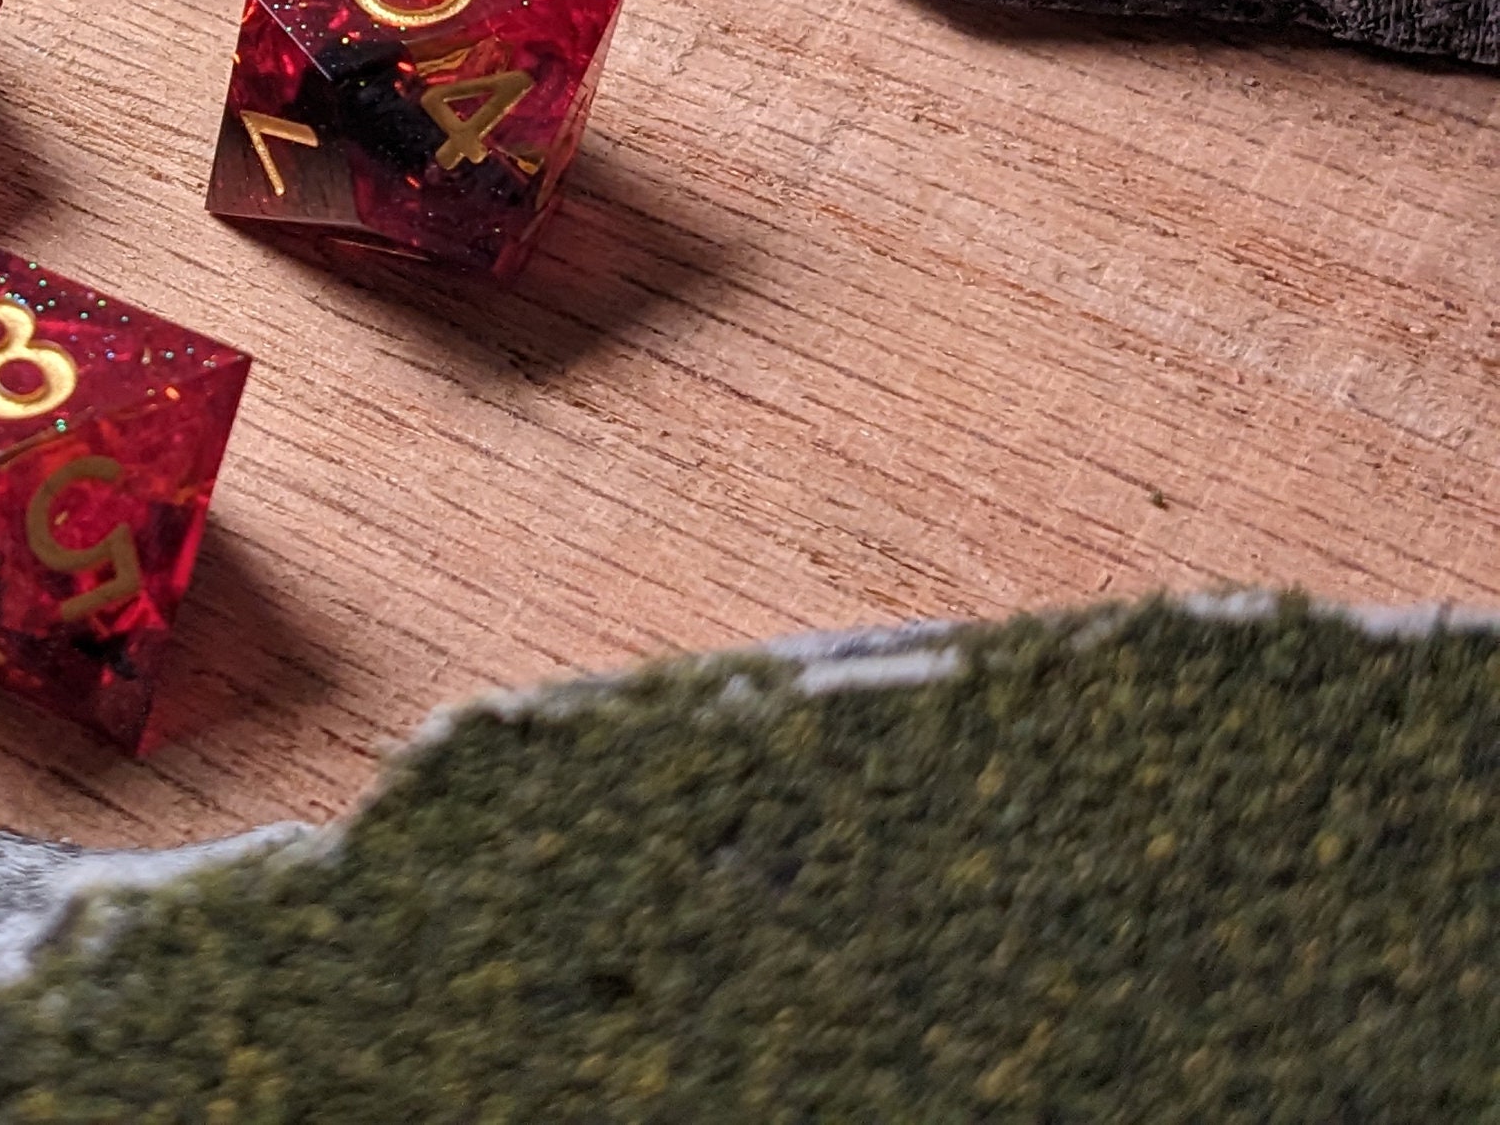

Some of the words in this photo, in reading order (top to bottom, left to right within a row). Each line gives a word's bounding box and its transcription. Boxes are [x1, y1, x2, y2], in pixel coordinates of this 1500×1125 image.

[239, 110, 320, 197] 7
[421, 70, 537, 171] 4
[25, 454, 143, 623] 5
